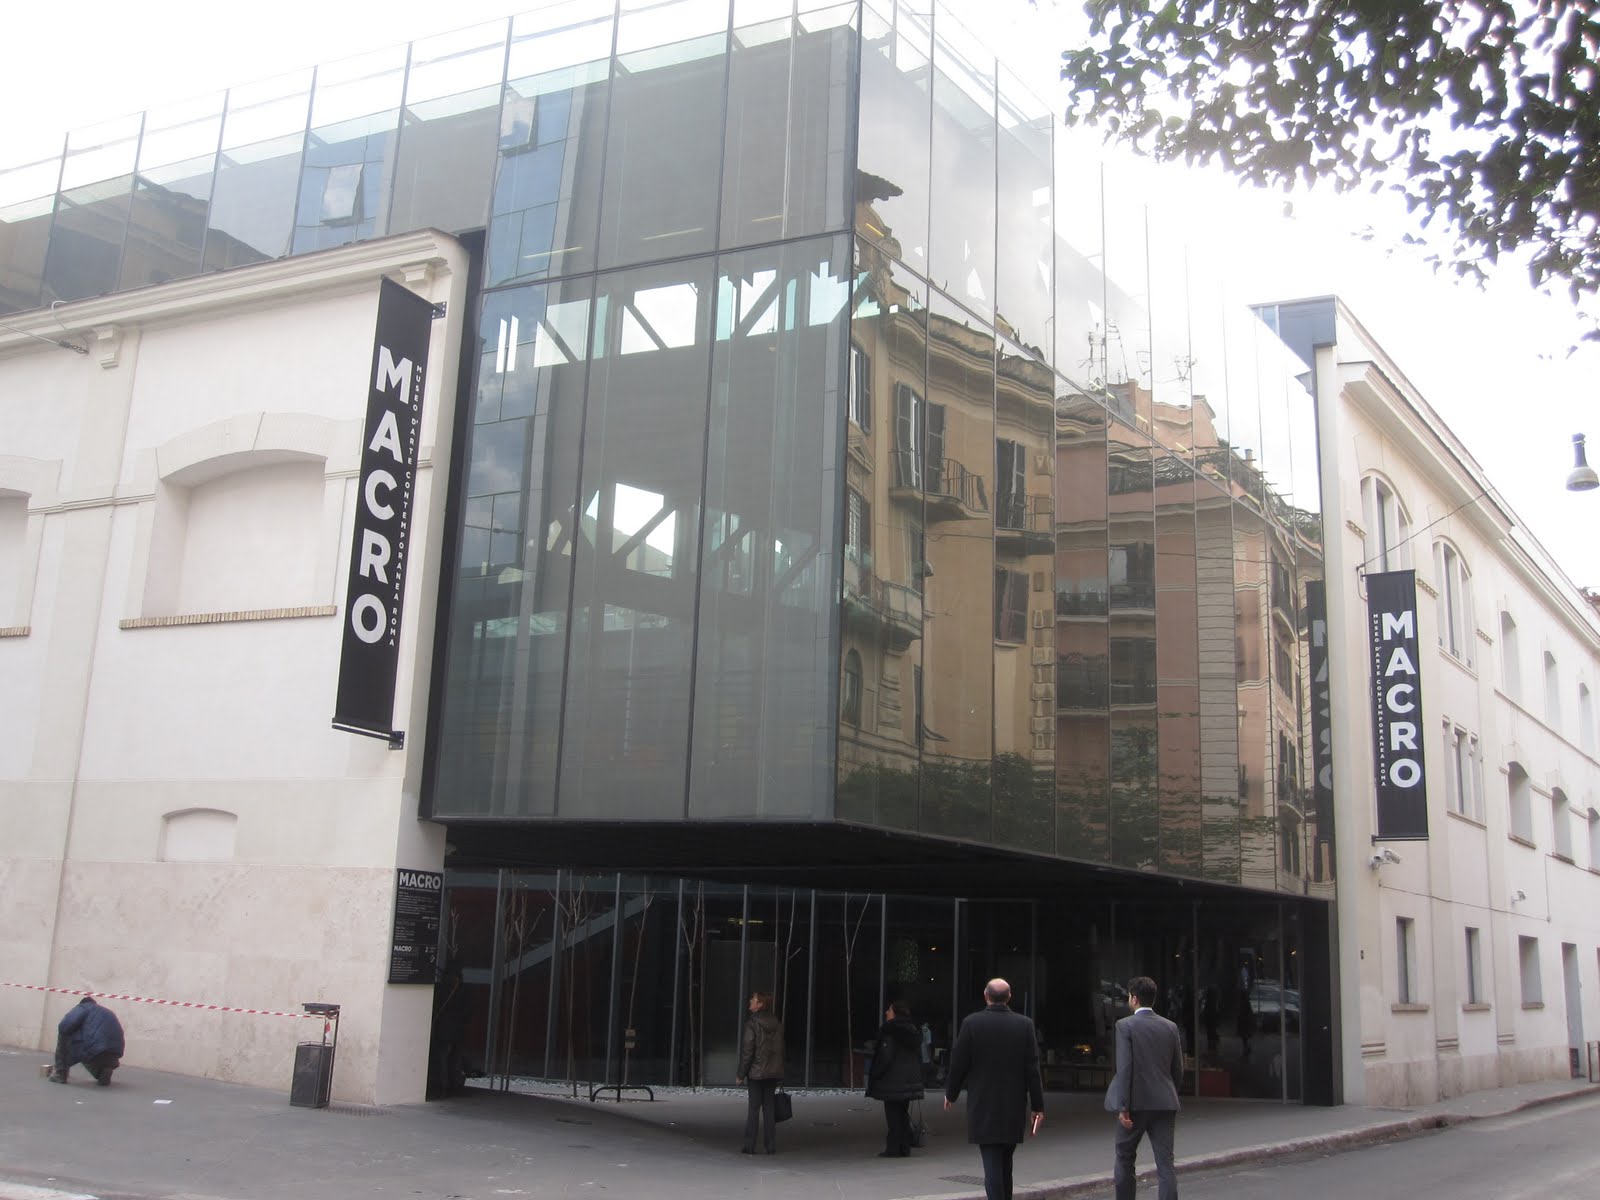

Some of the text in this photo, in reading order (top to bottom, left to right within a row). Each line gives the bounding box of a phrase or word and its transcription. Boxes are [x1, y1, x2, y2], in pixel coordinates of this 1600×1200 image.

[351, 344, 413, 644] MACRO
[389, 365, 422, 647] MUSEO D'ARTE CONTEMPORANEA ROMA
[1376, 680, 1385, 759] CONTEMPORANEA
[1382, 610, 1421, 788] MACRO
[399, 871, 441, 889] MACRO
